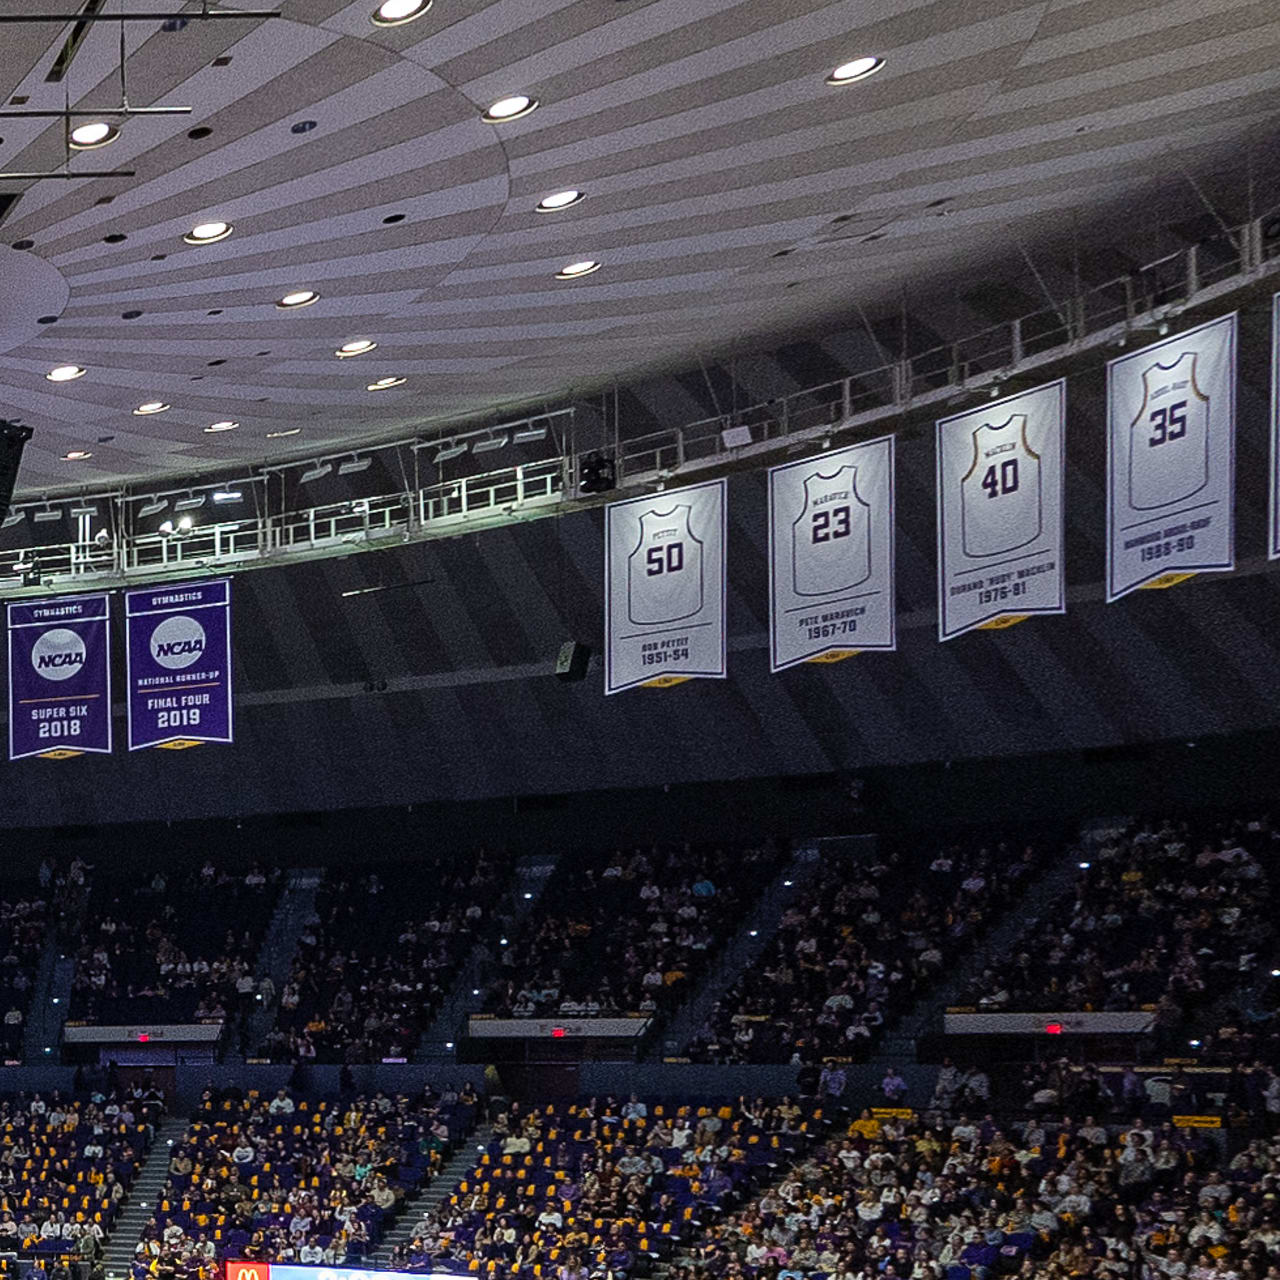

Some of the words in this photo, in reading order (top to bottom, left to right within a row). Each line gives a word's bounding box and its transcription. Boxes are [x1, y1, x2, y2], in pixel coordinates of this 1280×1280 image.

[1149, 400, 1187, 448] 35
[981, 458, 1019, 499] 40
[812, 506, 851, 544] 23
[646, 542, 684, 576] 50
[152, 592, 202, 606] GYMNASTICS
[33, 605, 83, 617] GYMNASTICS
[808, 621, 857, 640] 1967-70
[156, 639, 204, 657] NCAA
[38, 652, 83, 669] NCAA
[148, 697, 178, 710] FINAL
[181, 694, 210, 706] FOUR
[31, 708, 67, 720] SUPER
[69, 706, 88, 717] SIX
[158, 709, 200, 728] 2019
[39, 720, 81, 738] 2018
